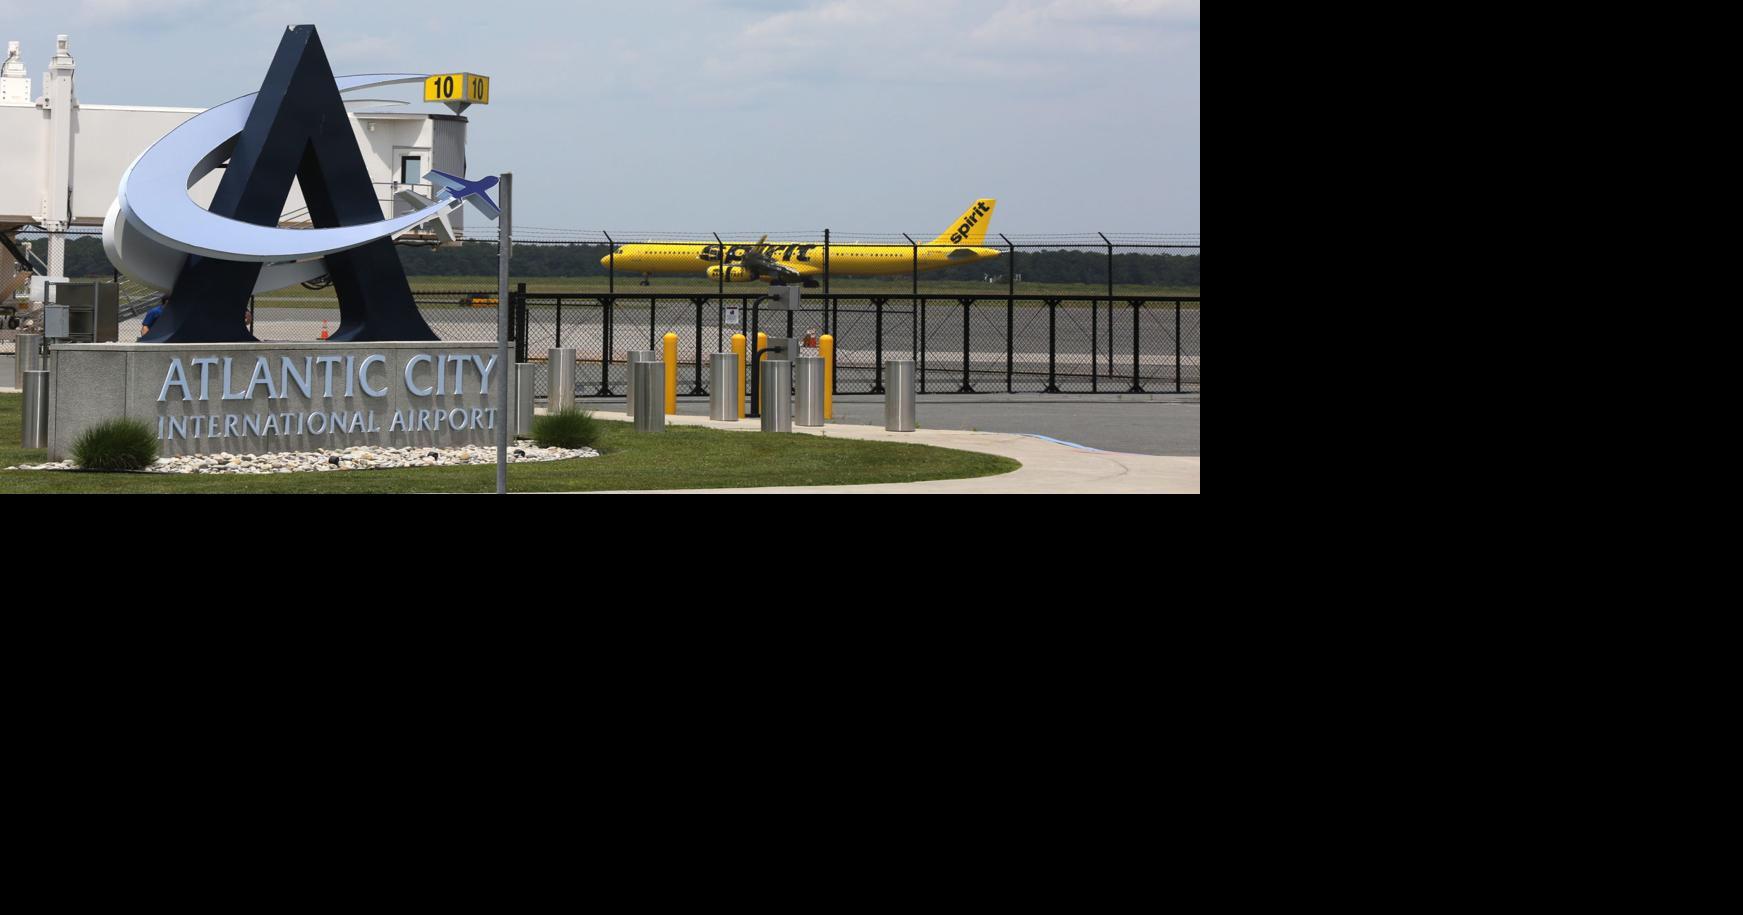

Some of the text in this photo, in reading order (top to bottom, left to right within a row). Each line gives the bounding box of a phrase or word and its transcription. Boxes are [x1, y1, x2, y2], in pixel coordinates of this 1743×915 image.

[434, 76, 454, 98] 10
[472, 77, 484, 100] 10
[950, 201, 990, 244] spirit
[699, 244, 817, 264] sprit
[157, 354, 498, 401] ATLANTIC CITY
[157, 407, 498, 440] INTERNATIONAL AIRPORT
